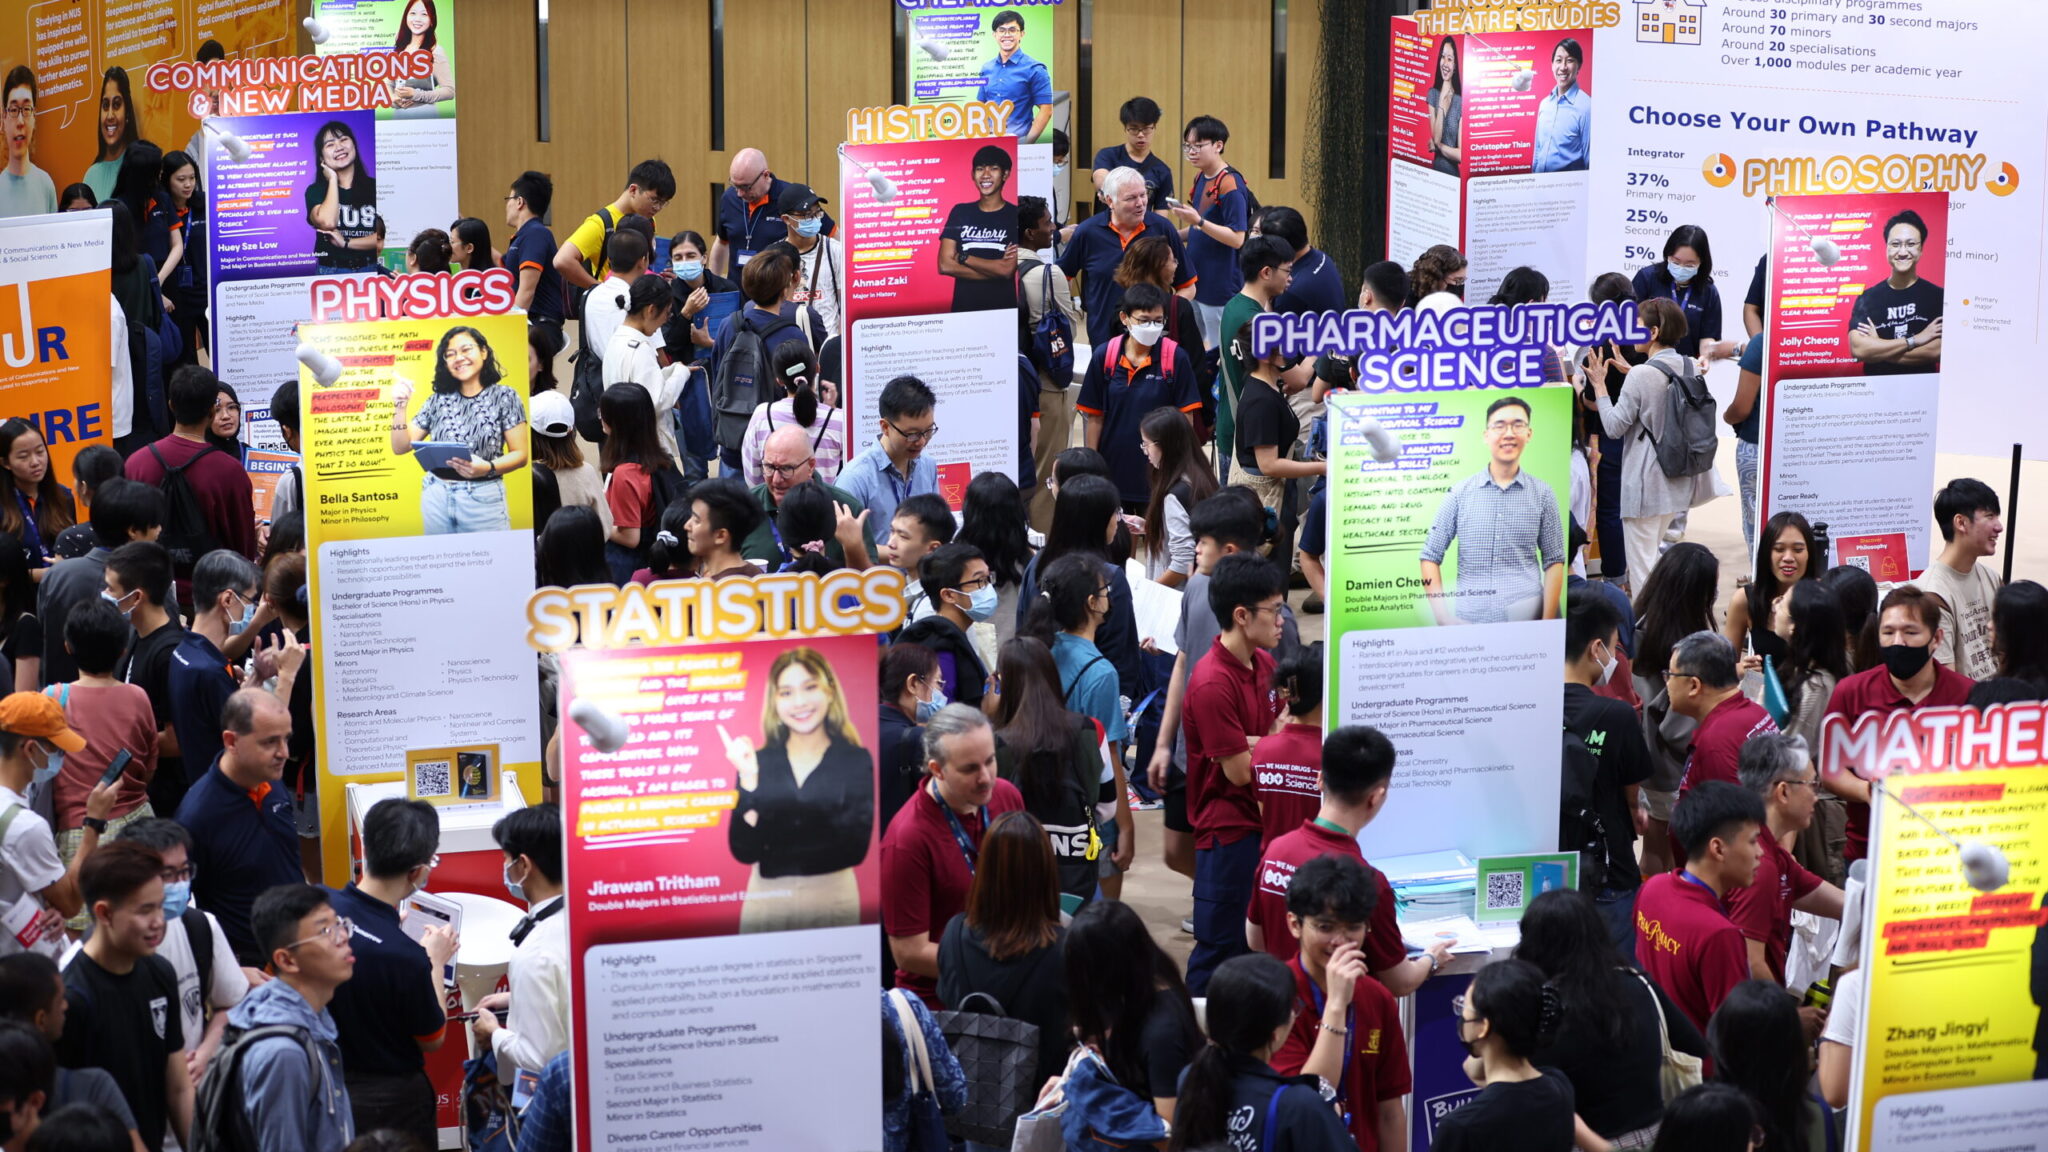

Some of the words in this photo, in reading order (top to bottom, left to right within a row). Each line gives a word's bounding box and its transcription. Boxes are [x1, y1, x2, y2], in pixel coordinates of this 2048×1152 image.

[1846, 0, 1923, 11] programmes
[36, 13, 61, 28] Studying
[63, 12, 67, 21] in
[69, 8, 81, 19] NUS
[1416, 9, 1516, 33] THEATRE
[1523, 5, 1619, 28] STUDIES
[1722, 7, 1765, 18] Around
[1770, 9, 1786, 19] 30
[1791, 12, 1837, 23] primary
[1842, 14, 1863, 23] and
[1869, 15, 1885, 24] 30
[1890, 17, 1931, 28] second
[1936, 19, 1978, 32] majors
[37, 30, 46, 41] has
[47, 26, 69, 40] inspired
[71, 22, 81, 33] and
[1722, 23, 1764, 35] Around
[1770, 26, 1786, 35] 70
[1791, 27, 1831, 38] minors
[37, 41, 63, 56] equipped
[74, 35, 87, 46] with
[1722, 39, 1764, 51] Around
[1769, 42, 1785, 51] 20
[1789, 44, 1876, 57] specialisations
[38, 58, 47, 68] the
[48, 55, 61, 66] skills
[63, 53, 69, 63] to
[71, 51, 89, 62] pursue
[1721, 55, 1749, 66] Over
[1755, 57, 1792, 68] 1,000
[1797, 59, 1846, 71] modules
[1851, 63, 1871, 74] per
[1875, 65, 1931, 77] academic
[1936, 68, 1962, 78] year
[38, 71, 58, 83] further
[60, 64, 87, 78] education
[148, 53, 431, 93] COMMUNICATIONS
[39, 89, 43, 97] in
[45, 79, 83, 95] mathematics.
[193, 93, 209, 115] &
[223, 89, 290, 113] NEW
[303, 83, 389, 108] MEDIA
[850, 102, 1012, 143] HISTORY
[1629, 106, 1721, 129] Choose
[1731, 112, 1790, 132] Your
[1799, 116, 1855, 136] Own
[1866, 120, 1978, 148] Pathway
[1470, 141, 1510, 151] Christopher
[1512, 140, 1530, 149] Thian
[1628, 148, 1685, 159] Integrator
[1627, 172, 1669, 188] 37%
[1745, 155, 1984, 195] PHILOSOPHY
[1626, 189, 1663, 201] Primary
[1668, 192, 1696, 202] major
[1626, 209, 1668, 224] 25%
[961, 225, 1007, 239] History
[1625, 226, 1660, 236] Second
[4, 245, 58, 255] Communications
[84, 239, 104, 247] Media
[218, 243, 239, 252] Huey
[1625, 246, 1655, 260] 5%
[10, 254, 29, 262] Social
[1965, 251, 1998, 262] minor)
[853, 277, 886, 287] Ahmad
[888, 276, 907, 285] Zaki
[314, 272, 512, 322] PHYSICS
[1887, 303, 1916, 320] NUS
[861, 321, 906, 331] Undergraduate
[908, 319, 943, 328] Programme
[1256, 304, 1649, 357] PHARMACEUTICAL
[1780, 336, 1801, 346] Jolly
[1804, 335, 1839, 346] Cheong
[861, 344, 892, 352] Highlights
[1779, 351, 1797, 359] Major
[1805, 349, 1832, 358] Philosophy
[1362, 347, 1543, 391] SCIENCE
[1792, 358, 1806, 366] Major
[1784, 382, 1829, 391] Undergraduate
[1831, 381, 1866, 389] Programme
[251, 462, 292, 472] BEGINS
[320, 494, 348, 504] Bella
[352, 492, 399, 502] Santosa
[1778, 493, 1799, 501] Career
[1800, 492, 1818, 500] Ready
[321, 509, 342, 517] Major
[351, 507, 377, 515] Physics
[351, 515, 390, 524] Philosophy
[330, 548, 370, 557] Highlights
[1856, 543, 1888, 551] Philosophy
[1346, 578, 1393, 591] Damien
[1396, 577, 1432, 588] Chew
[332, 590, 391, 601] Undergraduate
[393, 587, 443, 597] Programmes
[1345, 595, 1372, 603] Double
[1374, 594, 1398, 603] Majors
[1409, 589, 1466, 600] Pharmaceutical
[529, 570, 903, 649] STATISTICS
[1379, 603, 1413, 612] Analytics
[333, 611, 382, 621] Specialisations
[1352, 638, 1394, 648] Highlights
[335, 659, 358, 667] Minors
[1351, 698, 1413, 710] Undergraduate
[1416, 694, 1468, 706] Programmes
[337, 711, 373, 719] Research
[375, 708, 397, 716] Areas
[1351, 710, 1381, 720] Bachelor
[1382, 710, 1390, 718] of
[1392, 709, 1420, 718] Science
[1422, 707, 1444, 717] (Hons)
[1453, 703, 1507, 714] Pharmaceutical
[1509, 702, 1536, 711] Science
[1824, 706, 2048, 775] MATHE
[1275, 763, 1290, 771] MAKE
[1291, 765, 1311, 773] DRUGS
[1285, 779, 1319, 791] Science
[588, 878, 653, 897] Jirawan
[656, 874, 720, 889] Tritham
[589, 899, 622, 912] Double
[625, 897, 658, 910] Majors
[661, 896, 669, 905] in
[671, 893, 717, 906] Statistics
[719, 891, 737, 902] and
[1637, 910, 1681, 956] PHARMACY
[601, 953, 656, 967] Highlights
[604, 1027, 684, 1044] Undergraduate
[687, 1022, 757, 1036] Programmes
[1887, 1025, 1936, 1042] Zhang
[1941, 1018, 1989, 1036] Jingyi
[605, 1056, 672, 1070] Specialisations
[607, 1131, 647, 1144] Diverse
[650, 1126, 686, 1140] Career
[689, 1122, 762, 1139] Opportunities
